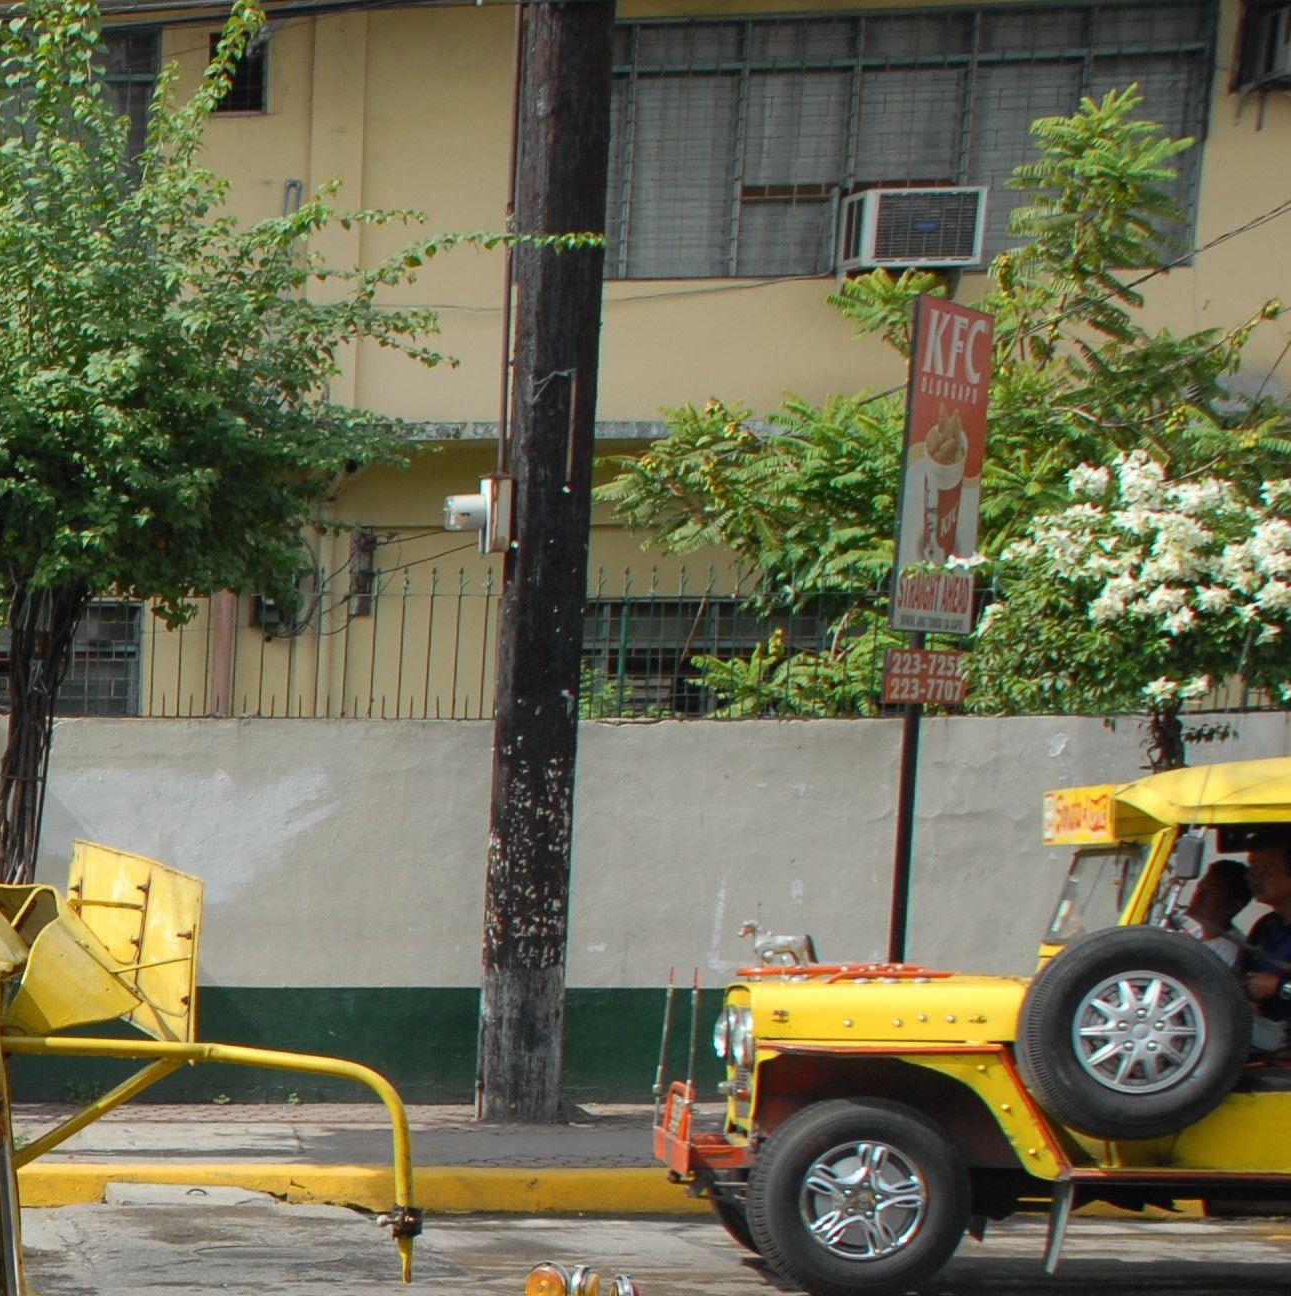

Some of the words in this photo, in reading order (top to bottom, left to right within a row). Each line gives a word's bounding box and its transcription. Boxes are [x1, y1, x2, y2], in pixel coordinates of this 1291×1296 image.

[921, 309, 988, 385] KFC
[921, 376, 979, 405] OLONGAPO
[941, 570, 971, 614] AHEAD
